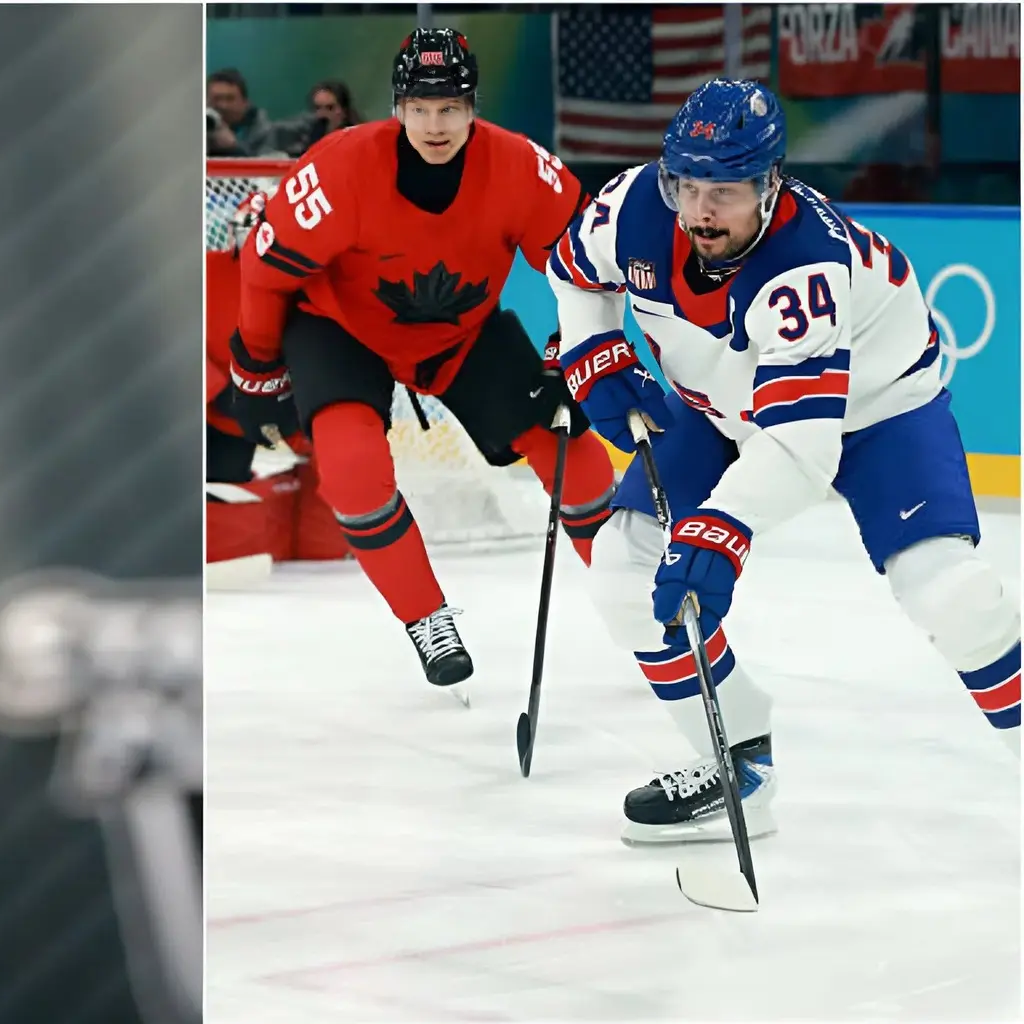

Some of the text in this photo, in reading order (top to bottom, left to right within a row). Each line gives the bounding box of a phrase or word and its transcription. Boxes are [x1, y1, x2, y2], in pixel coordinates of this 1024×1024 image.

[778, 4, 860, 66] FORZA
[285, 162, 333, 230] 55
[768, 272, 837, 342] 34
